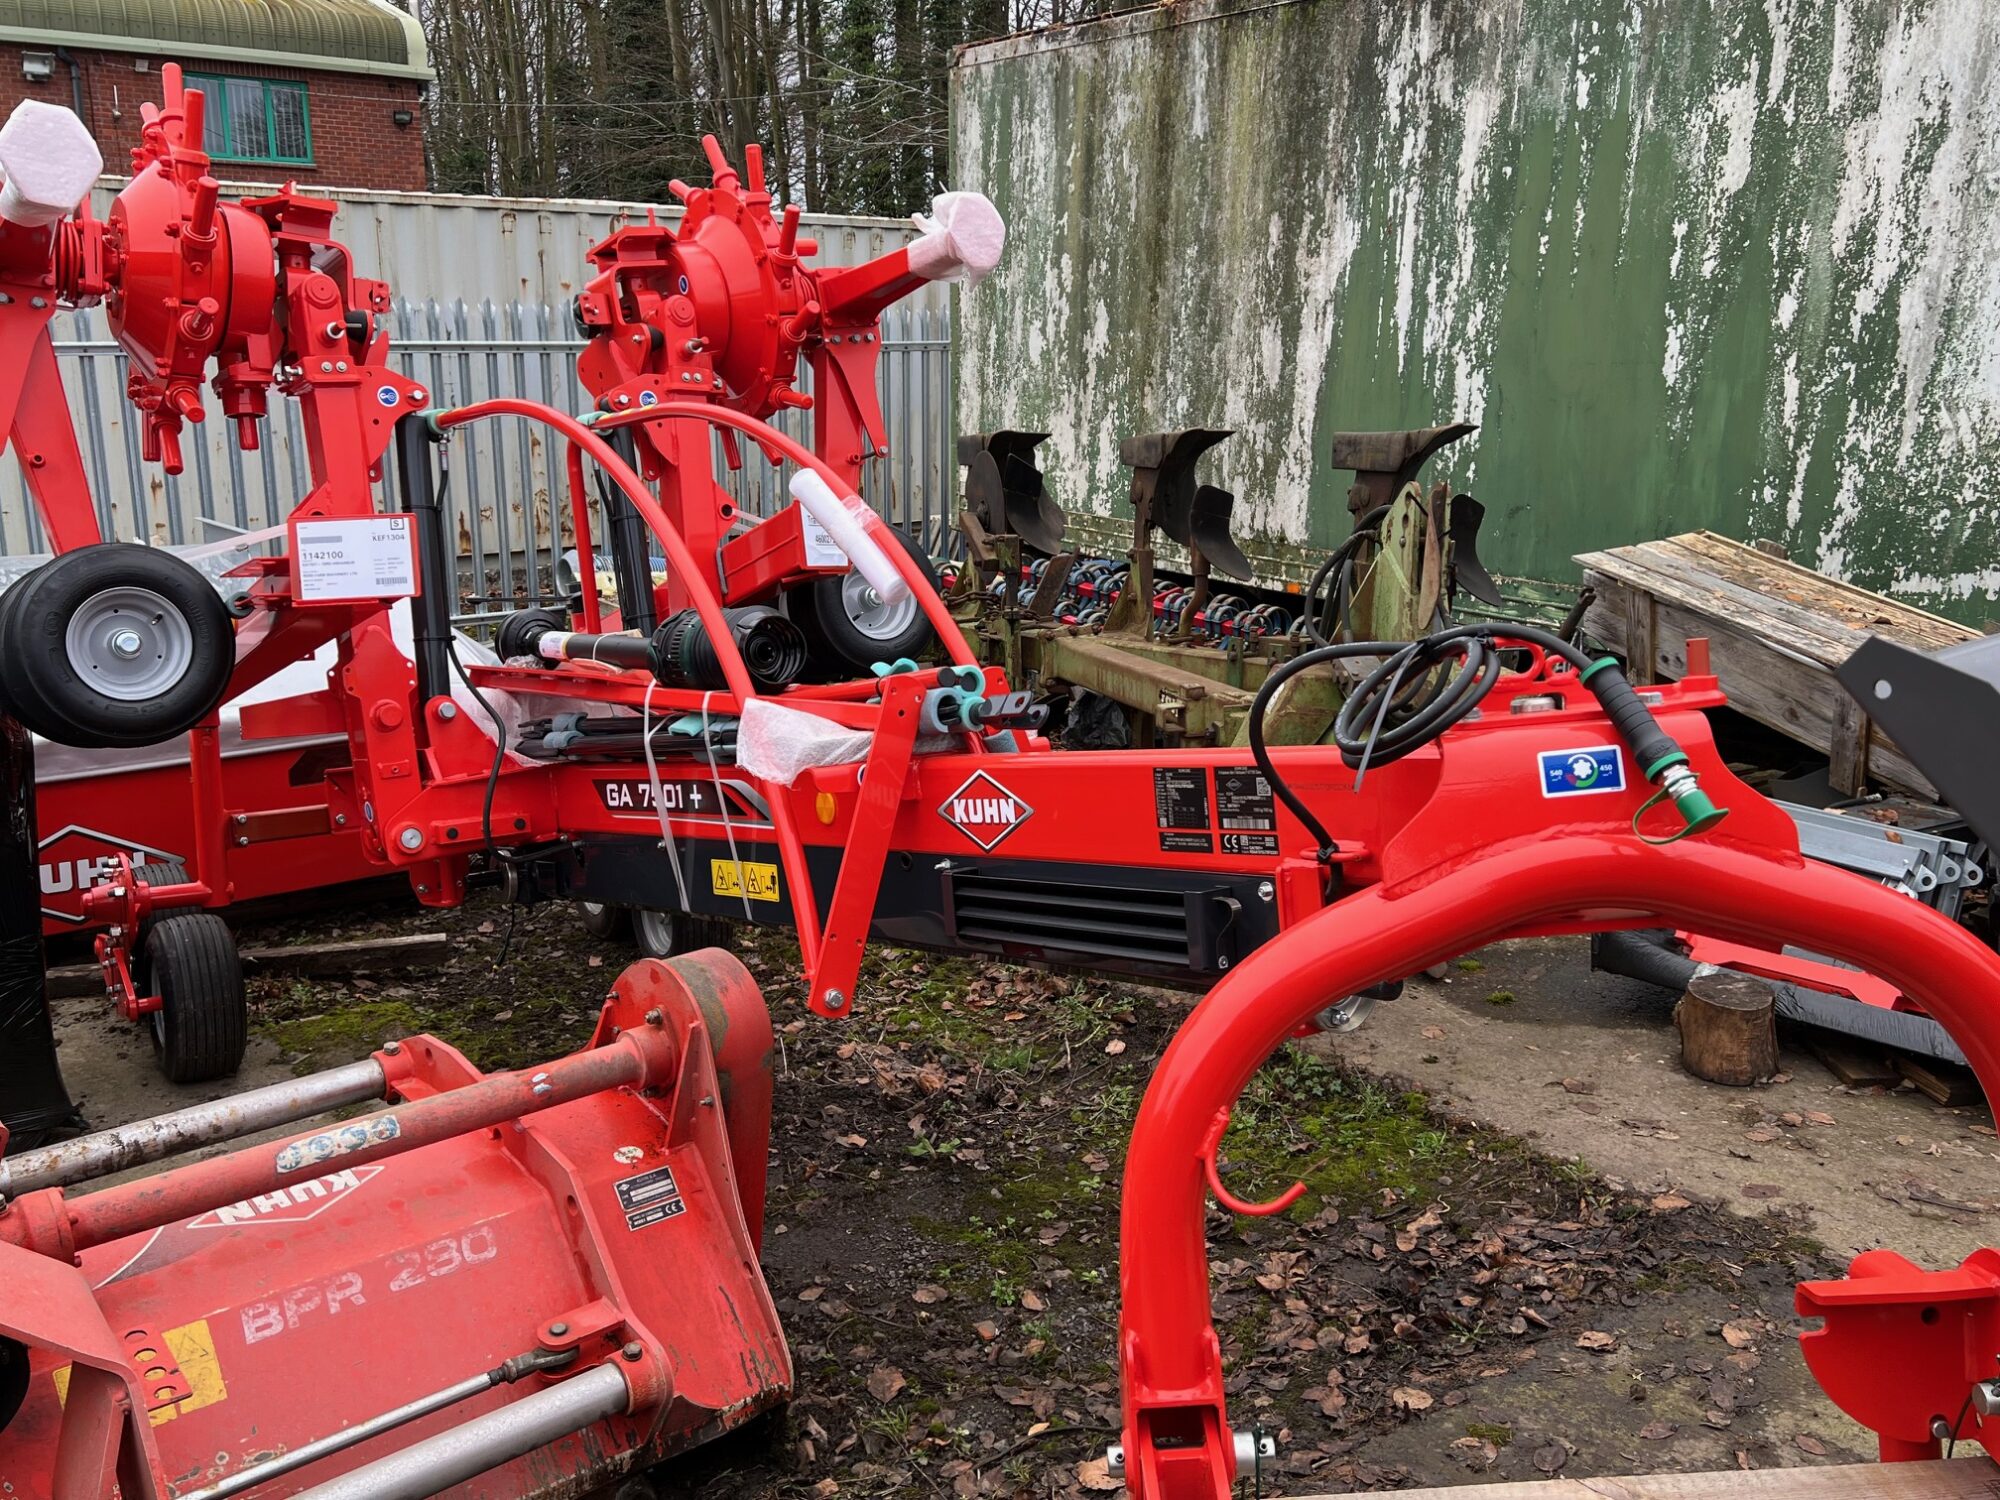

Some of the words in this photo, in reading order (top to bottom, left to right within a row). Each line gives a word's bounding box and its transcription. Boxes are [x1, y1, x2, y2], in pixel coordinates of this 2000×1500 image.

[393, 519, 400, 528] S
[372, 533, 405, 542] KEF1304
[302, 550, 344, 560] 1142100
[606, 783, 633, 807] GA
[953, 798, 1016, 824] KUHN
[215, 1168, 361, 1224] KUHN
[240, 1272, 366, 1345] BPR
